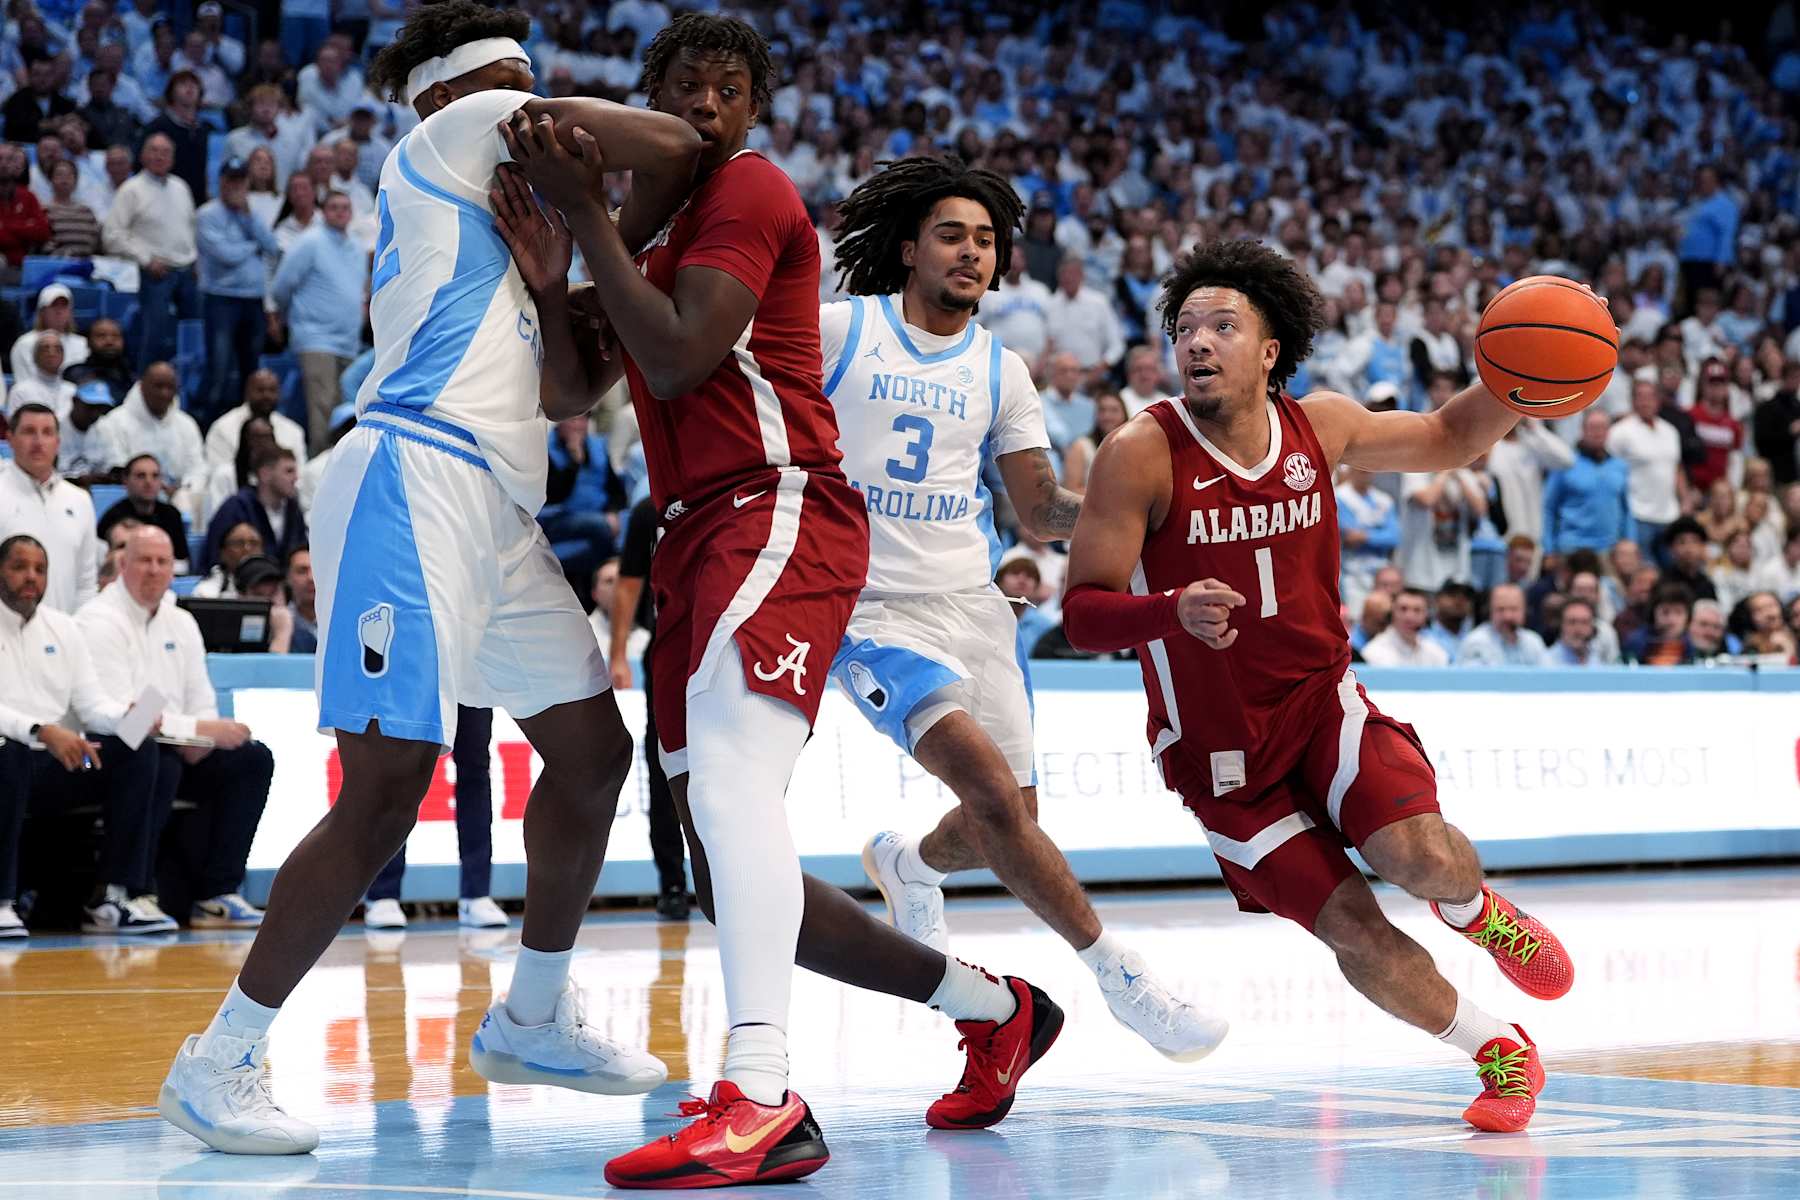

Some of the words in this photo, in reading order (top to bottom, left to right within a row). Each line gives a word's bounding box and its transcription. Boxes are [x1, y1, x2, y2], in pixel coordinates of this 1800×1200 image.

[868, 373, 968, 421] NORTH
[885, 412, 935, 484] 3
[1285, 454, 1310, 482] SEC
[850, 480, 968, 521] ROLINA
[1187, 491, 1321, 545] ALABAMA
[1255, 547, 1278, 618] 1
[753, 632, 811, 696] A
[1436, 748, 1590, 791] ATTERS
[1603, 746, 1710, 787] MOST
